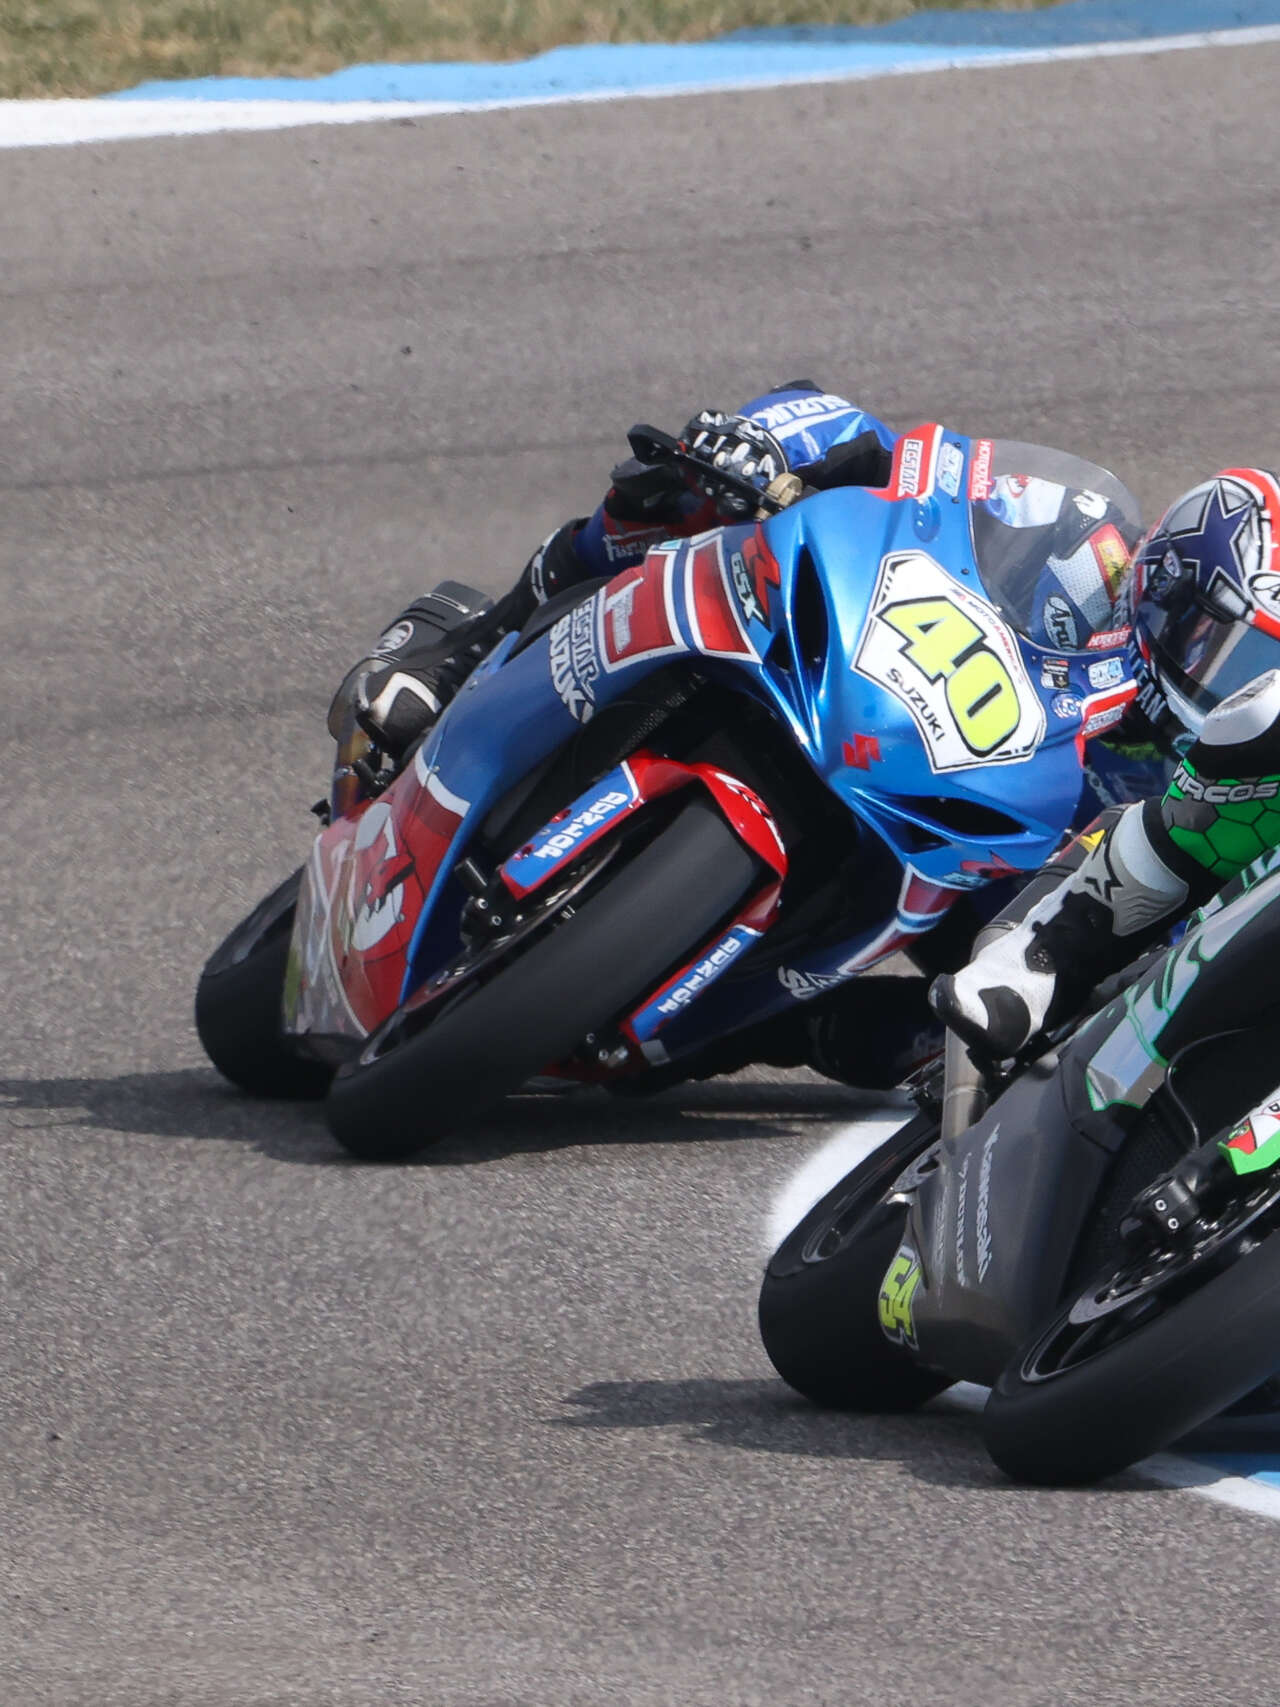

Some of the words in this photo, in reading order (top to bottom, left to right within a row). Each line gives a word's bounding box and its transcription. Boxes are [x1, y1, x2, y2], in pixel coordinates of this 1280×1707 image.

[900, 440, 922, 497] ECSTAR
[875, 596, 1022, 759] 40
[885, 667, 946, 742] SUZUKI
[1172, 762, 1280, 804] VIRCOS
[534, 790, 629, 860] DUNLOP
[657, 936, 742, 1014] DUNLOP
[880, 1256, 921, 1337] 54
